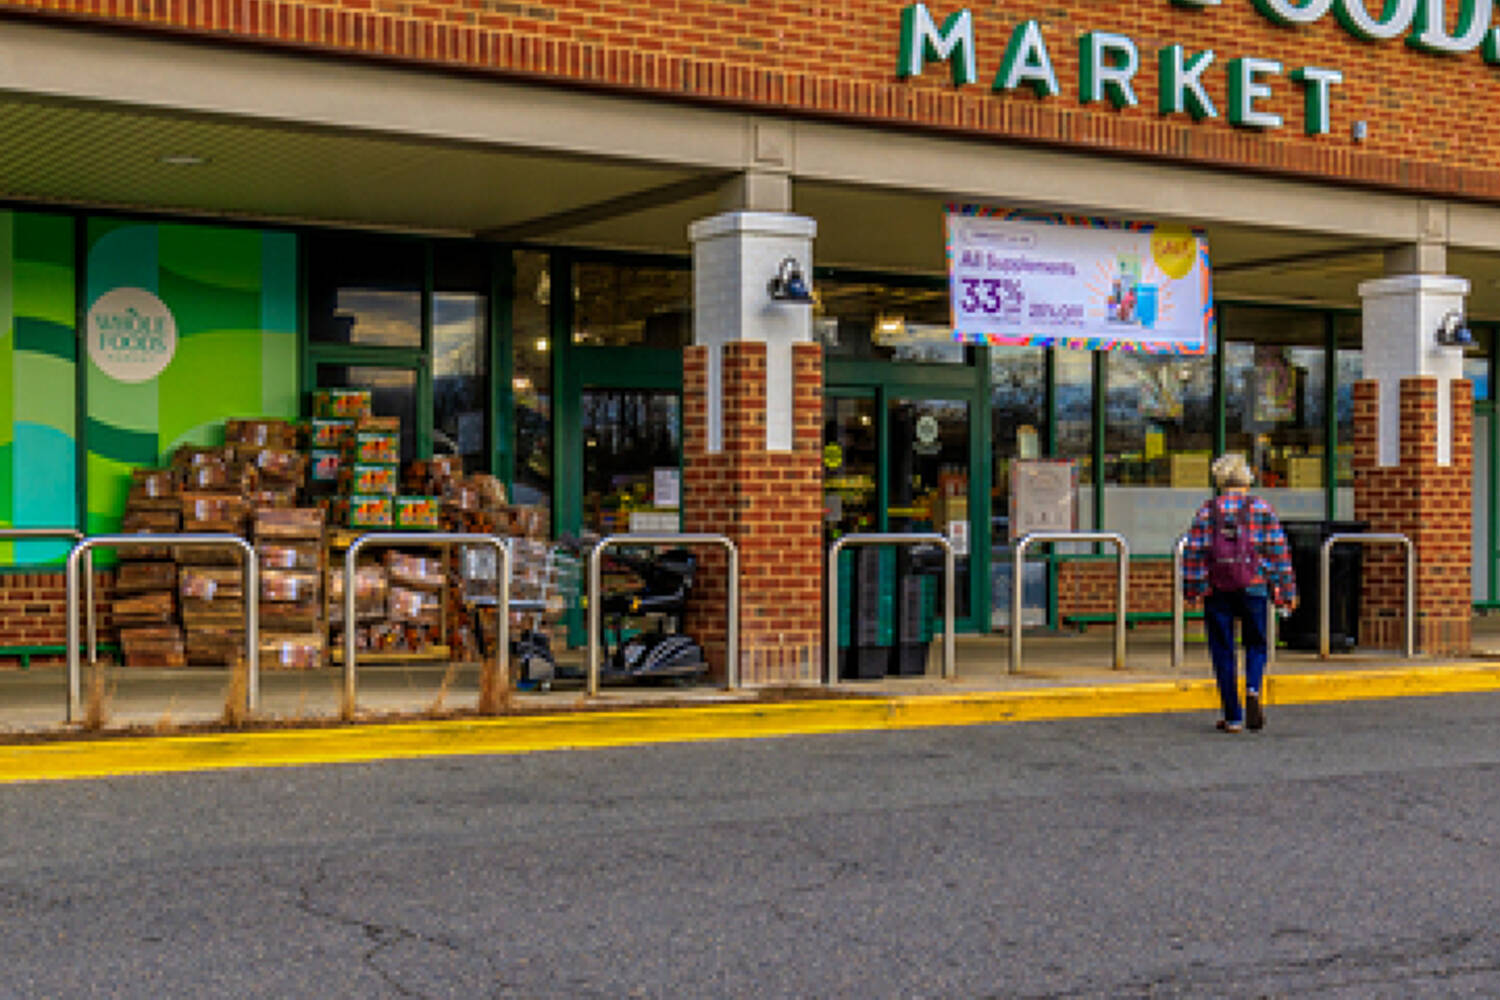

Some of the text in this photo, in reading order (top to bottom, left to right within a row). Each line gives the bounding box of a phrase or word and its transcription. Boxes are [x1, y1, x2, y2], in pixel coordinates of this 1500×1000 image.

[898, 1, 1343, 136] MARKET
[987, 253, 1076, 276] Supplements
[95, 308, 167, 333] WHOLE
[99, 333, 167, 353] FOODS
